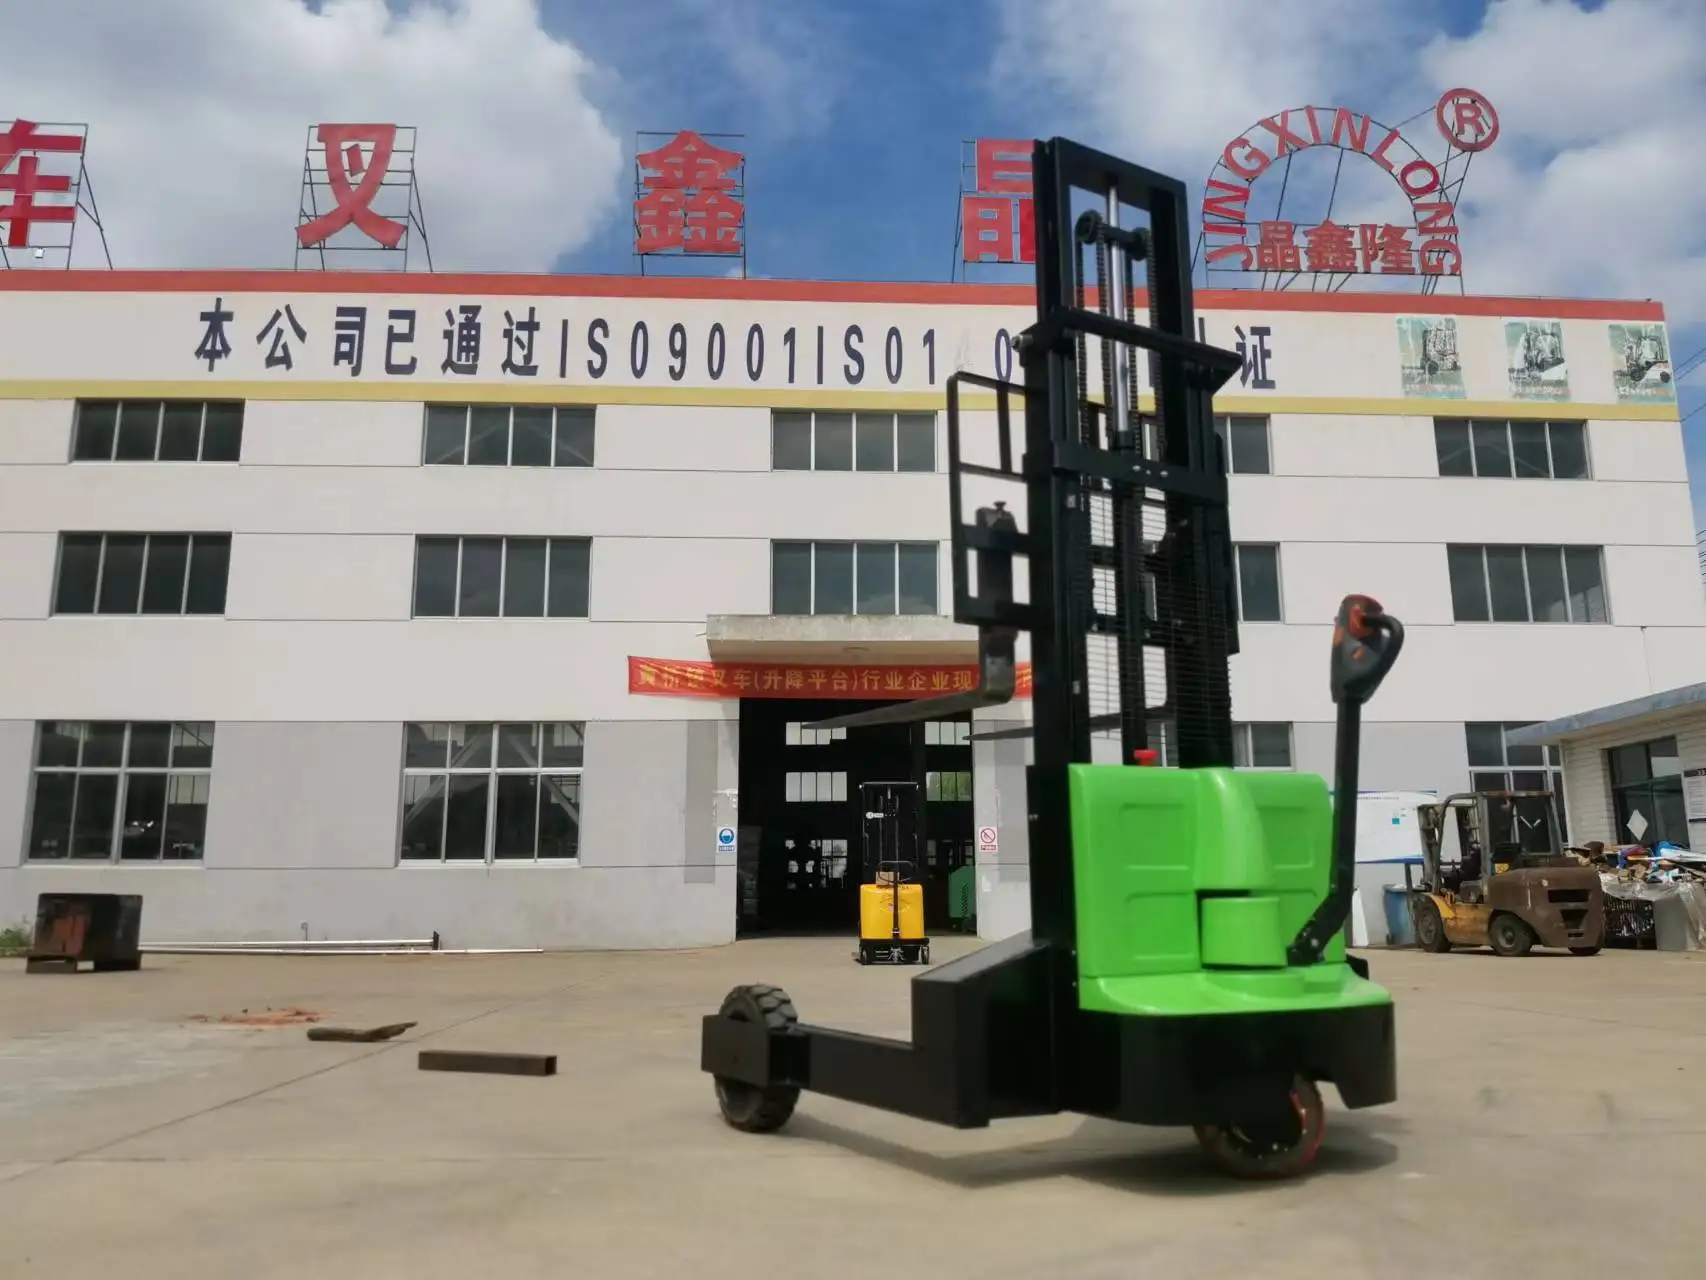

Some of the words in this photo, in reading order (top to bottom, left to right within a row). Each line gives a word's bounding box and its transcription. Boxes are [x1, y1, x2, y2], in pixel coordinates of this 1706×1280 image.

[1203, 105, 1462, 275] JINGXINLONG
[1257, 220, 1416, 274] 晶鑫隆
